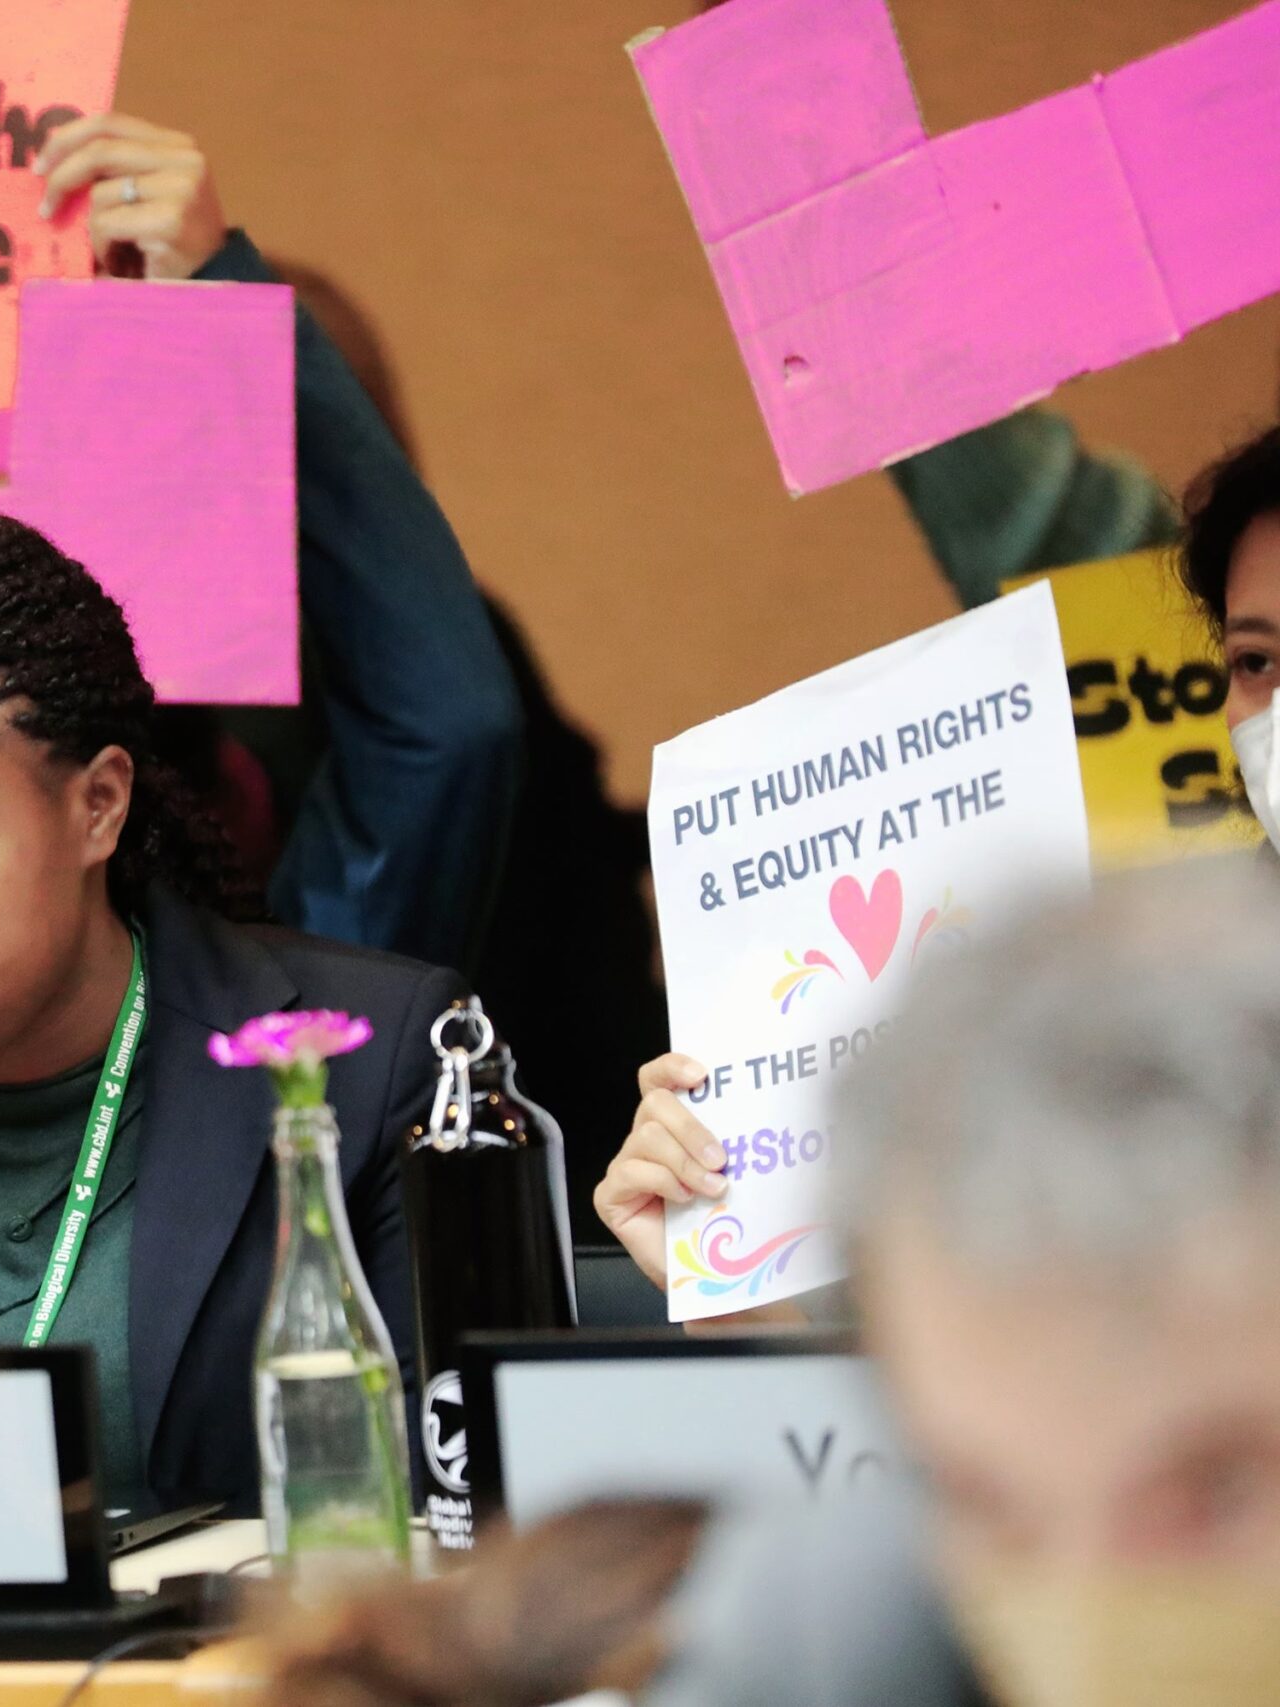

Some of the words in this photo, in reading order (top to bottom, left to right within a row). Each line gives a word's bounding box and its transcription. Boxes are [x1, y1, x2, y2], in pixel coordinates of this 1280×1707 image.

[672, 787, 741, 844] PUT
[752, 734, 889, 817] HUMAN
[896, 683, 1034, 765] RIGHTS
[699, 872, 726, 911] &
[732, 820, 865, 902] EQUITY
[877, 799, 921, 851] AT
[931, 770, 1006, 829] THE
[110, 1010, 142, 1077] Convention
[688, 1064, 733, 1104] OF
[744, 1043, 819, 1090] THE
[83, 1104, 114, 1178] www.cbd.int
[721, 1124, 831, 1181] #Sto
[55, 1209, 86, 1263] Diversity
[36, 1263, 67, 1322] Biological
[32, 1322, 45, 1338] on
